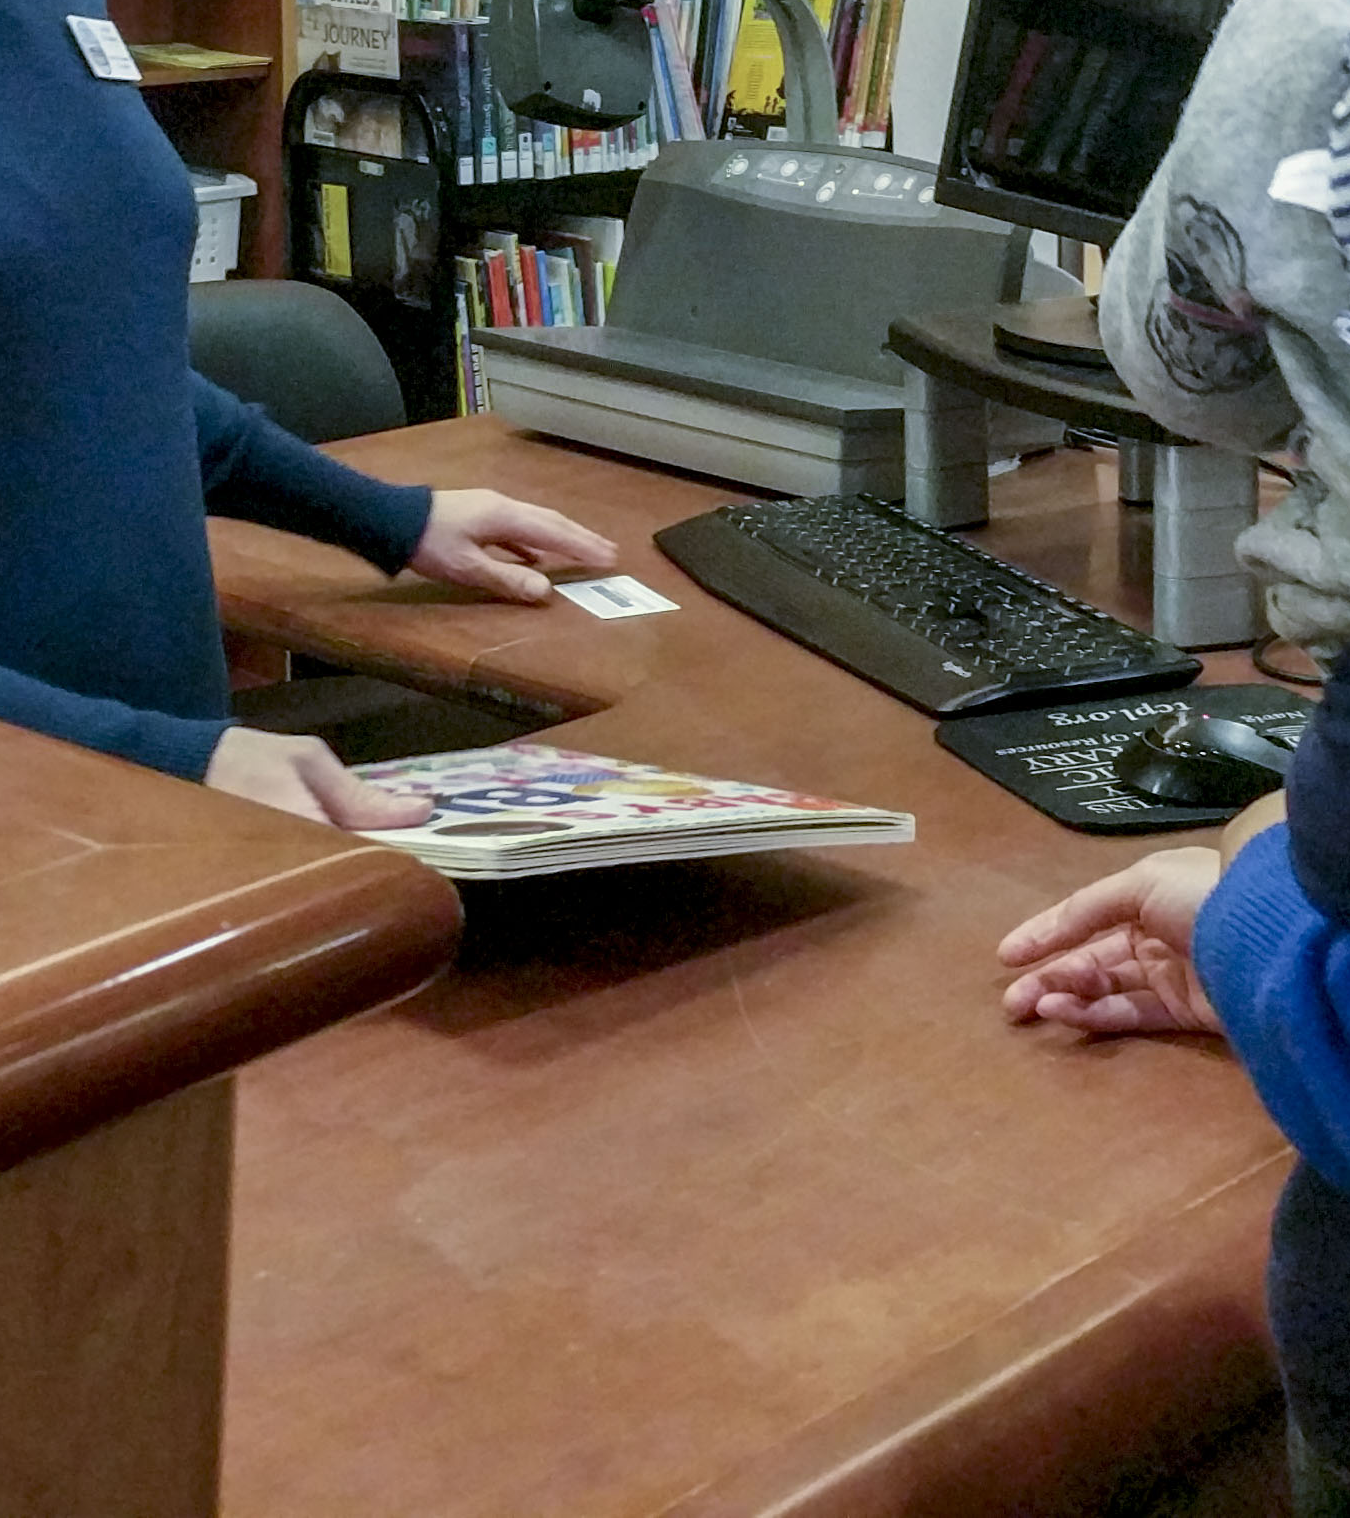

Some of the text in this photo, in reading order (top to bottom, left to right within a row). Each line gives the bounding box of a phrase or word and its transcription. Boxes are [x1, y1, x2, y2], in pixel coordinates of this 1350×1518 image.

[322, 23, 390, 50] JOURNEY
[1047, 700, 1193, 728] tcpl.org
[994, 735, 1099, 757] Resources
